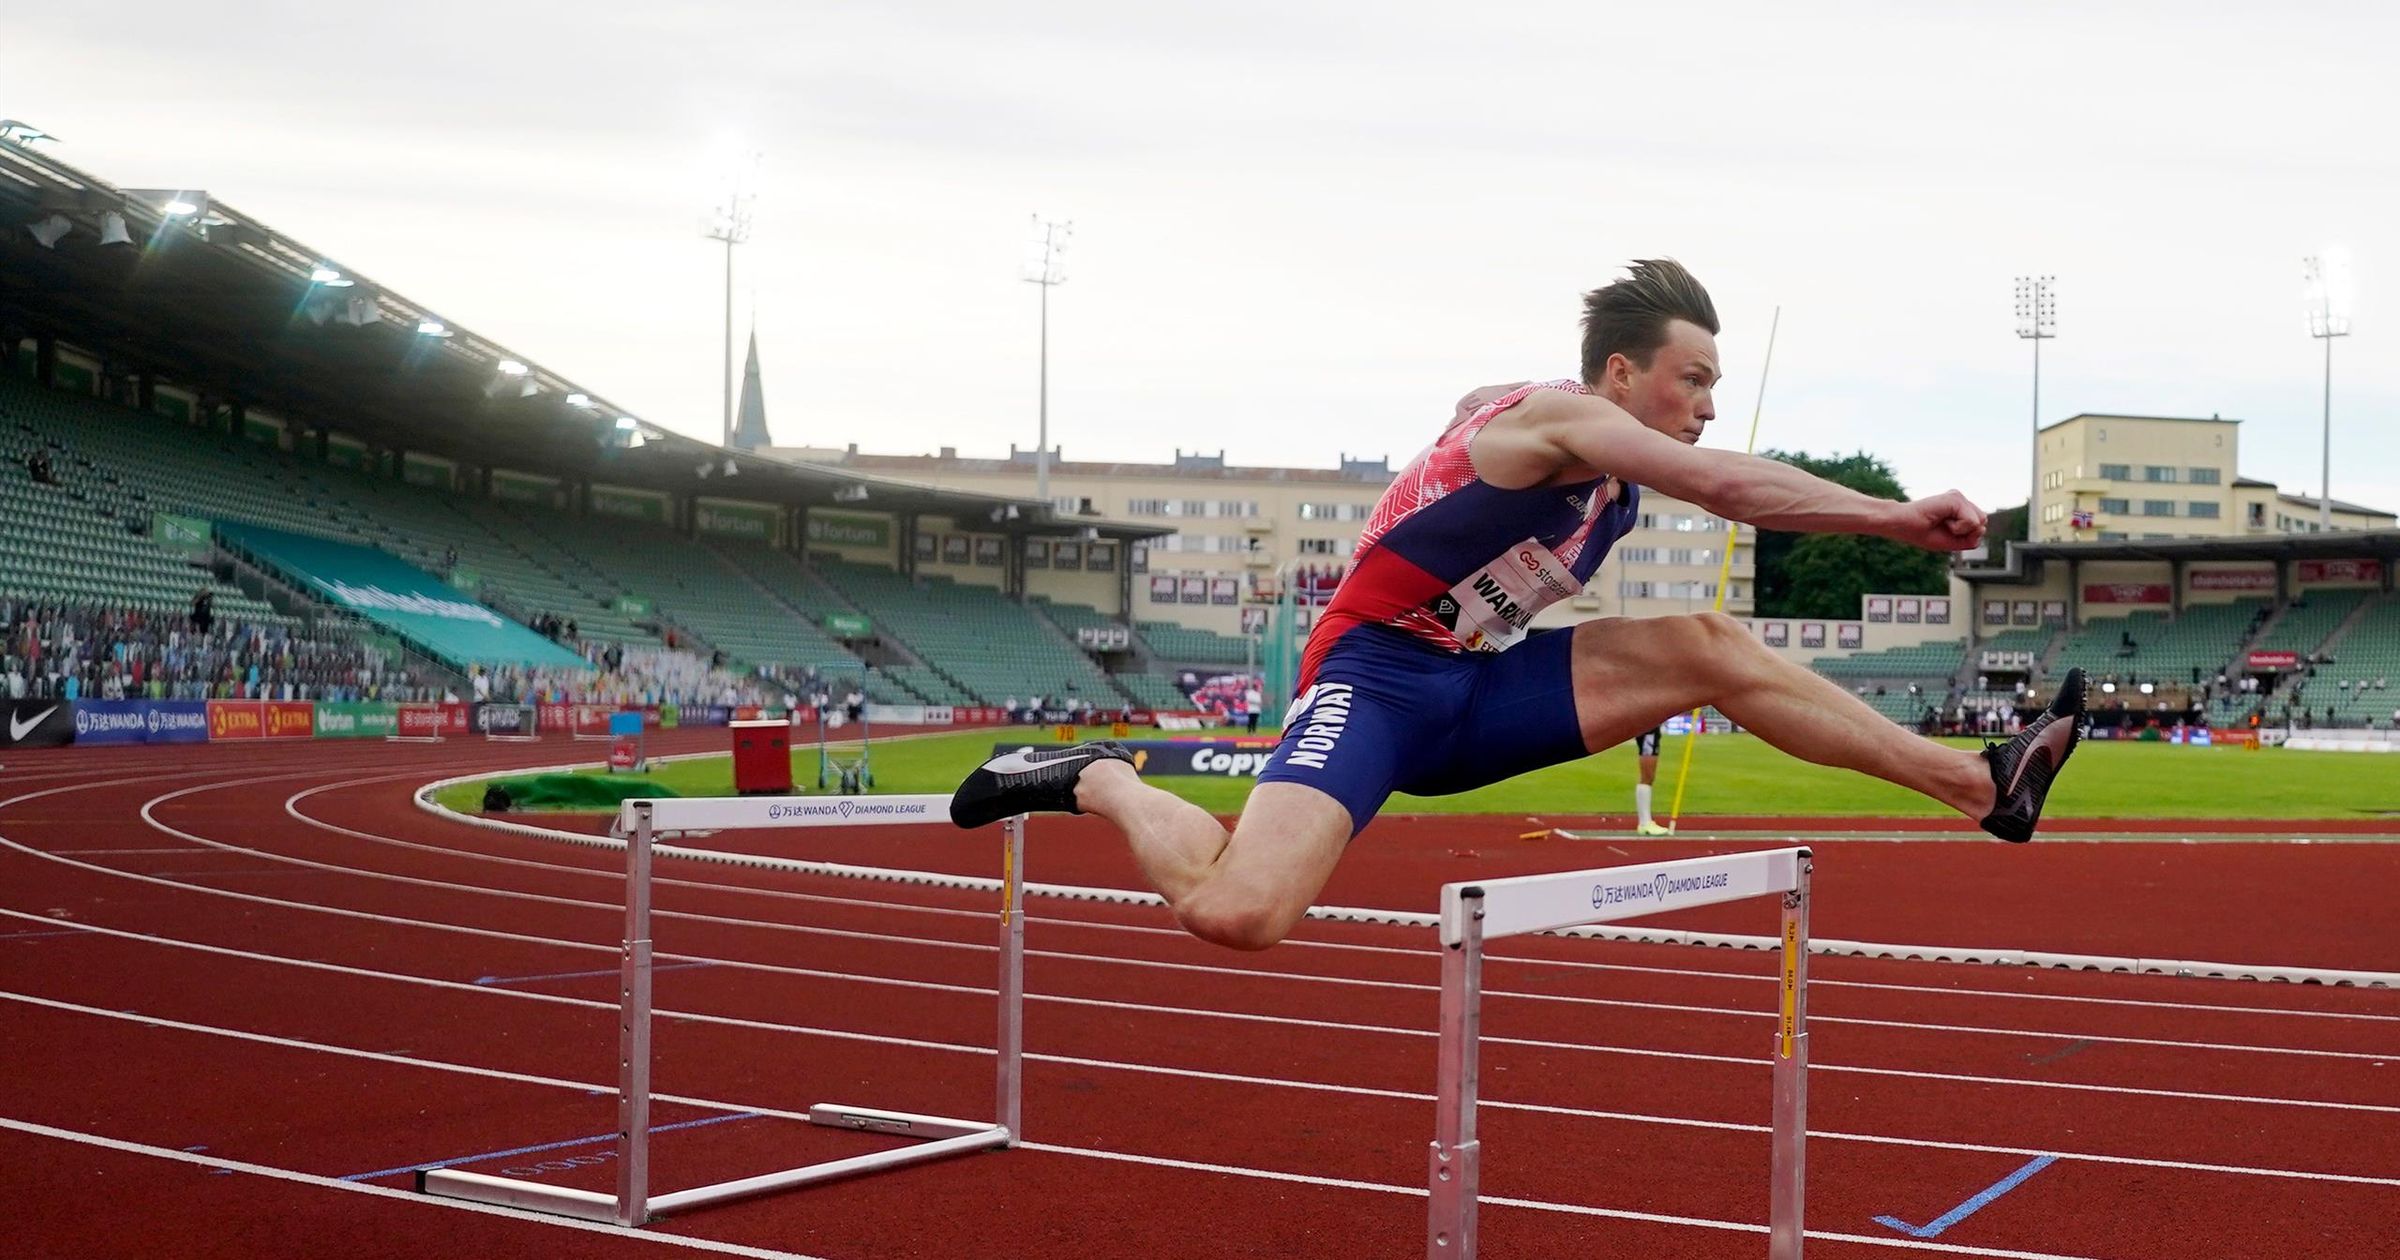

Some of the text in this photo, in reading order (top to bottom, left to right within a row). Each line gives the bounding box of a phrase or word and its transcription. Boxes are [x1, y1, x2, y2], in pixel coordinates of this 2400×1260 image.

[823, 520, 877, 542] fortum
[228, 711, 260, 728] EXTRA
[282, 711, 310, 727] EXTRA
[1286, 683, 1353, 769] NORWAY
[855, 804, 894, 815] DIAMOND
[895, 803, 926, 814] LEAGUE
[1668, 876, 1701, 894] DIAMOND
[1702, 873, 1728, 889] LEAGUE
